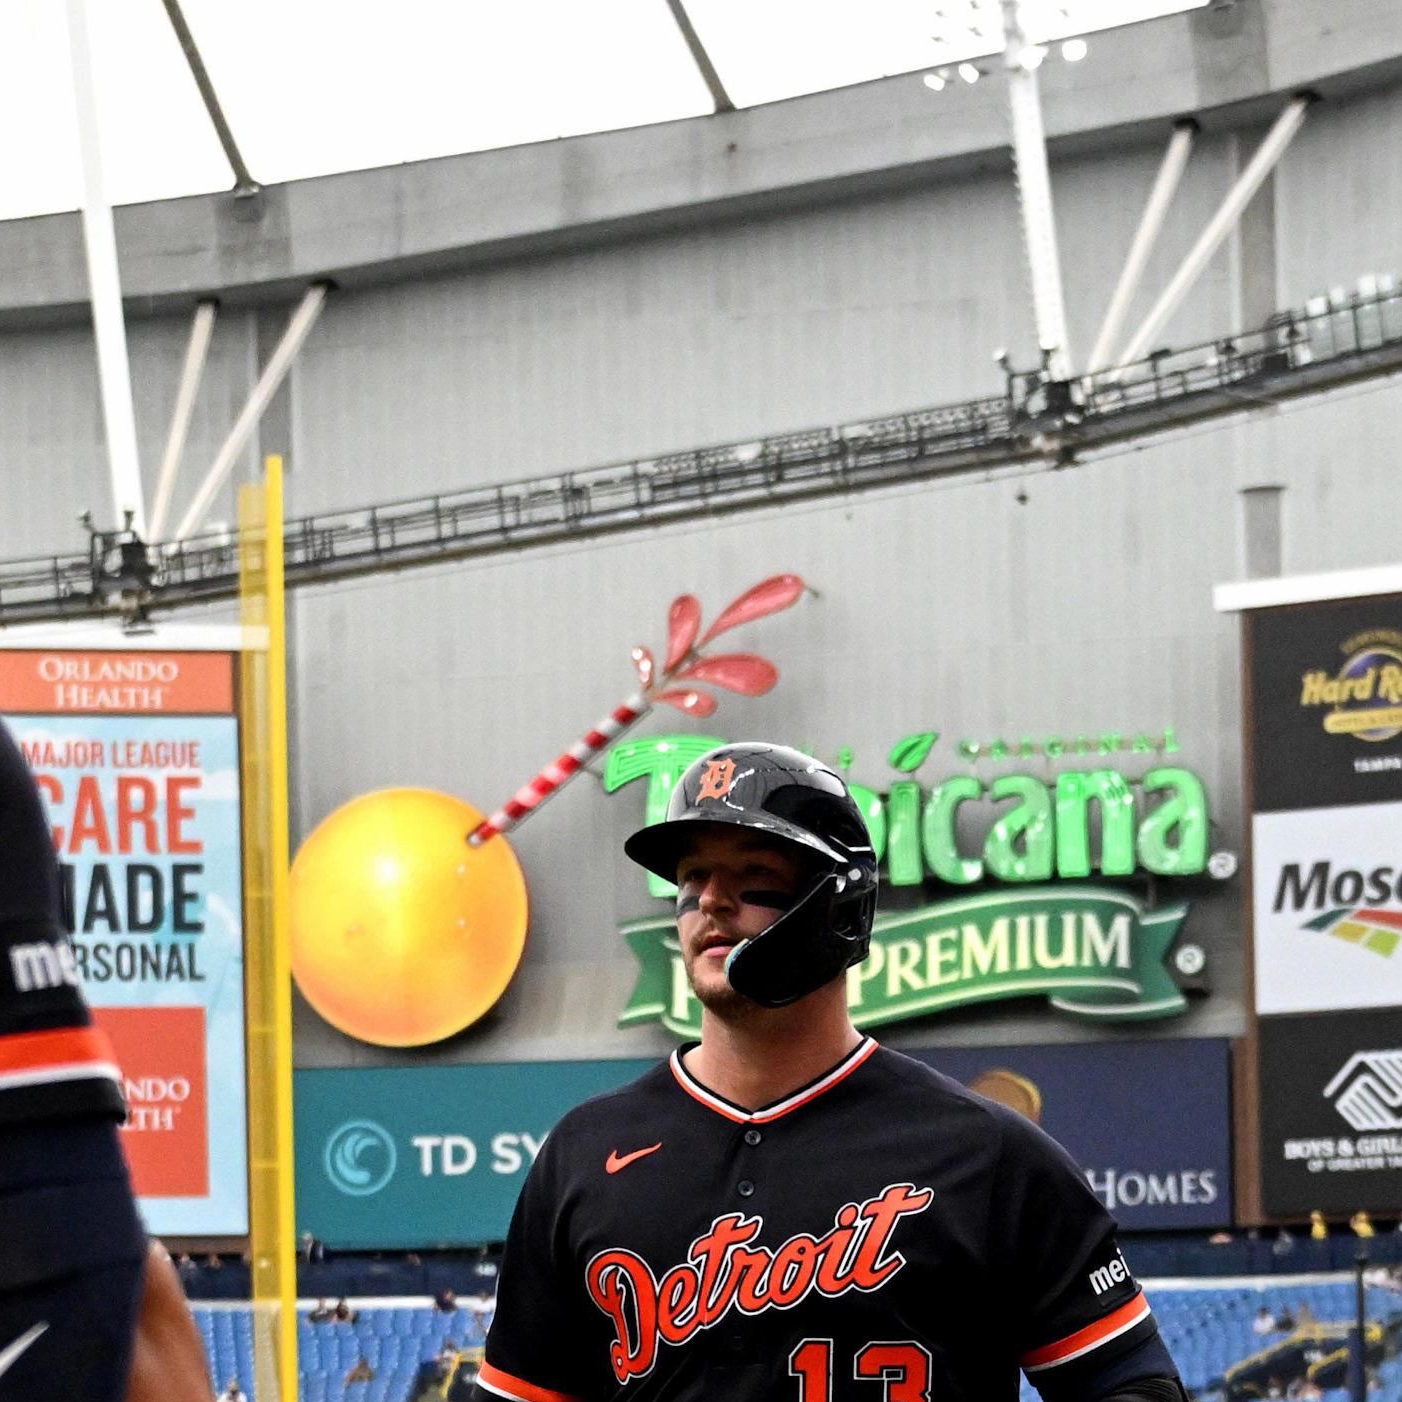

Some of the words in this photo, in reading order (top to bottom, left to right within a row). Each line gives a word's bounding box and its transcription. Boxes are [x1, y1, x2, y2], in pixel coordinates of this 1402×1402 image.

[38, 656, 180, 682] ORLANDO
[1299, 669, 1376, 706] Hard
[56, 684, 164, 709] HEALTH
[21, 741, 105, 769] MAJOR
[112, 740, 201, 769] LEAGUE
[604, 735, 1209, 898] Ticana
[72, 942, 207, 983] RSONAL
[846, 911, 1133, 1007] PREMIUM
[411, 1135, 478, 1177] TD
[1284, 1138, 1336, 1160] BOYS
[1338, 1136, 1355, 1157] &
[1083, 1165, 1219, 1210] HOMES
[584, 1182, 934, 1386] Detroit
